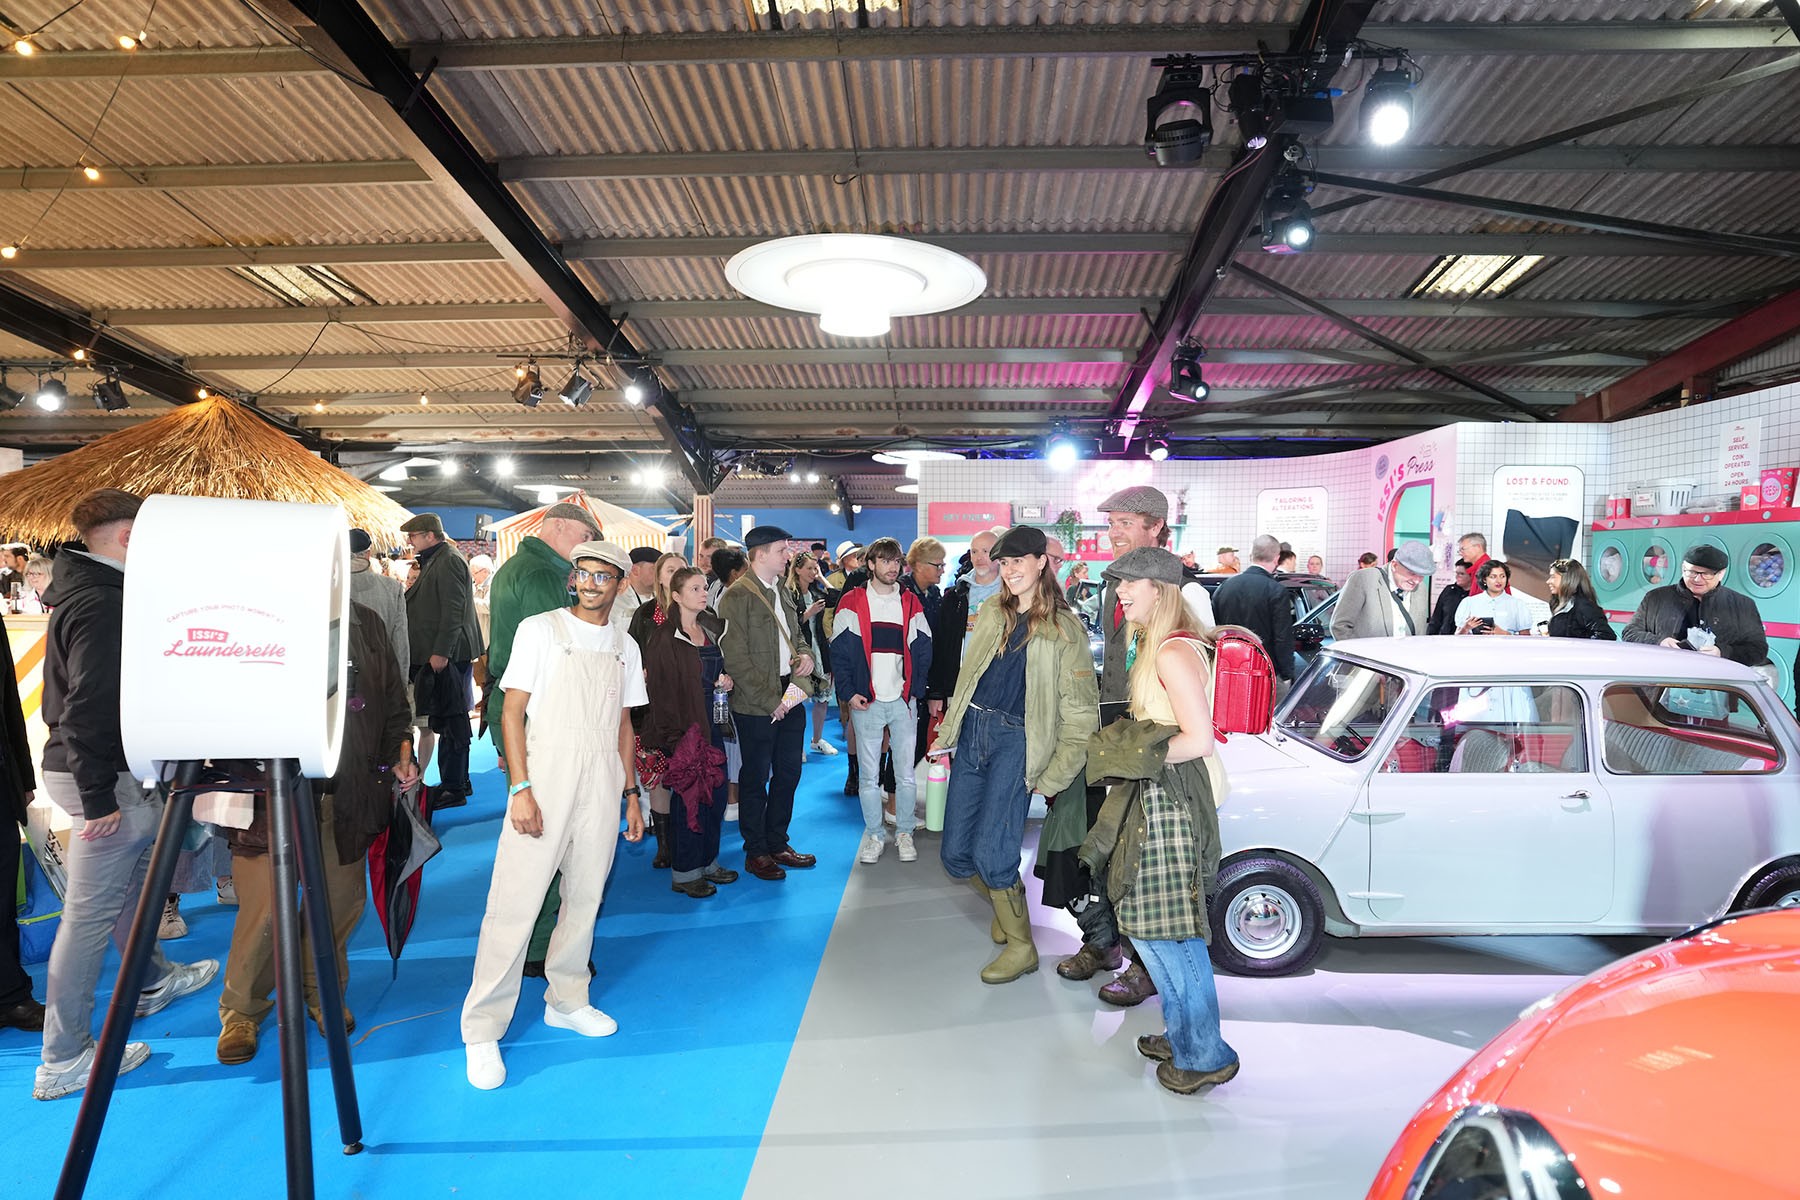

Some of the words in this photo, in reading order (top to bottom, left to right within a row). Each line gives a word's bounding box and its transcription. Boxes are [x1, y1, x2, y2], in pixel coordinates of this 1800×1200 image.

[1506, 477, 1529, 486] LOST
[1531, 477, 1538, 486] &
[1540, 477, 1569, 486] FOUND
[1732, 478, 1749, 486] HOURS
[1377, 463, 1405, 523] ISSI'S
[1407, 455, 1434, 476] Press
[943, 513, 959, 522] HEY
[166, 607, 198, 624] CAPTURE
[200, 604, 219, 612] YOUR
[221, 604, 245, 612] PHOTO
[163, 639, 287, 658] Launderette
